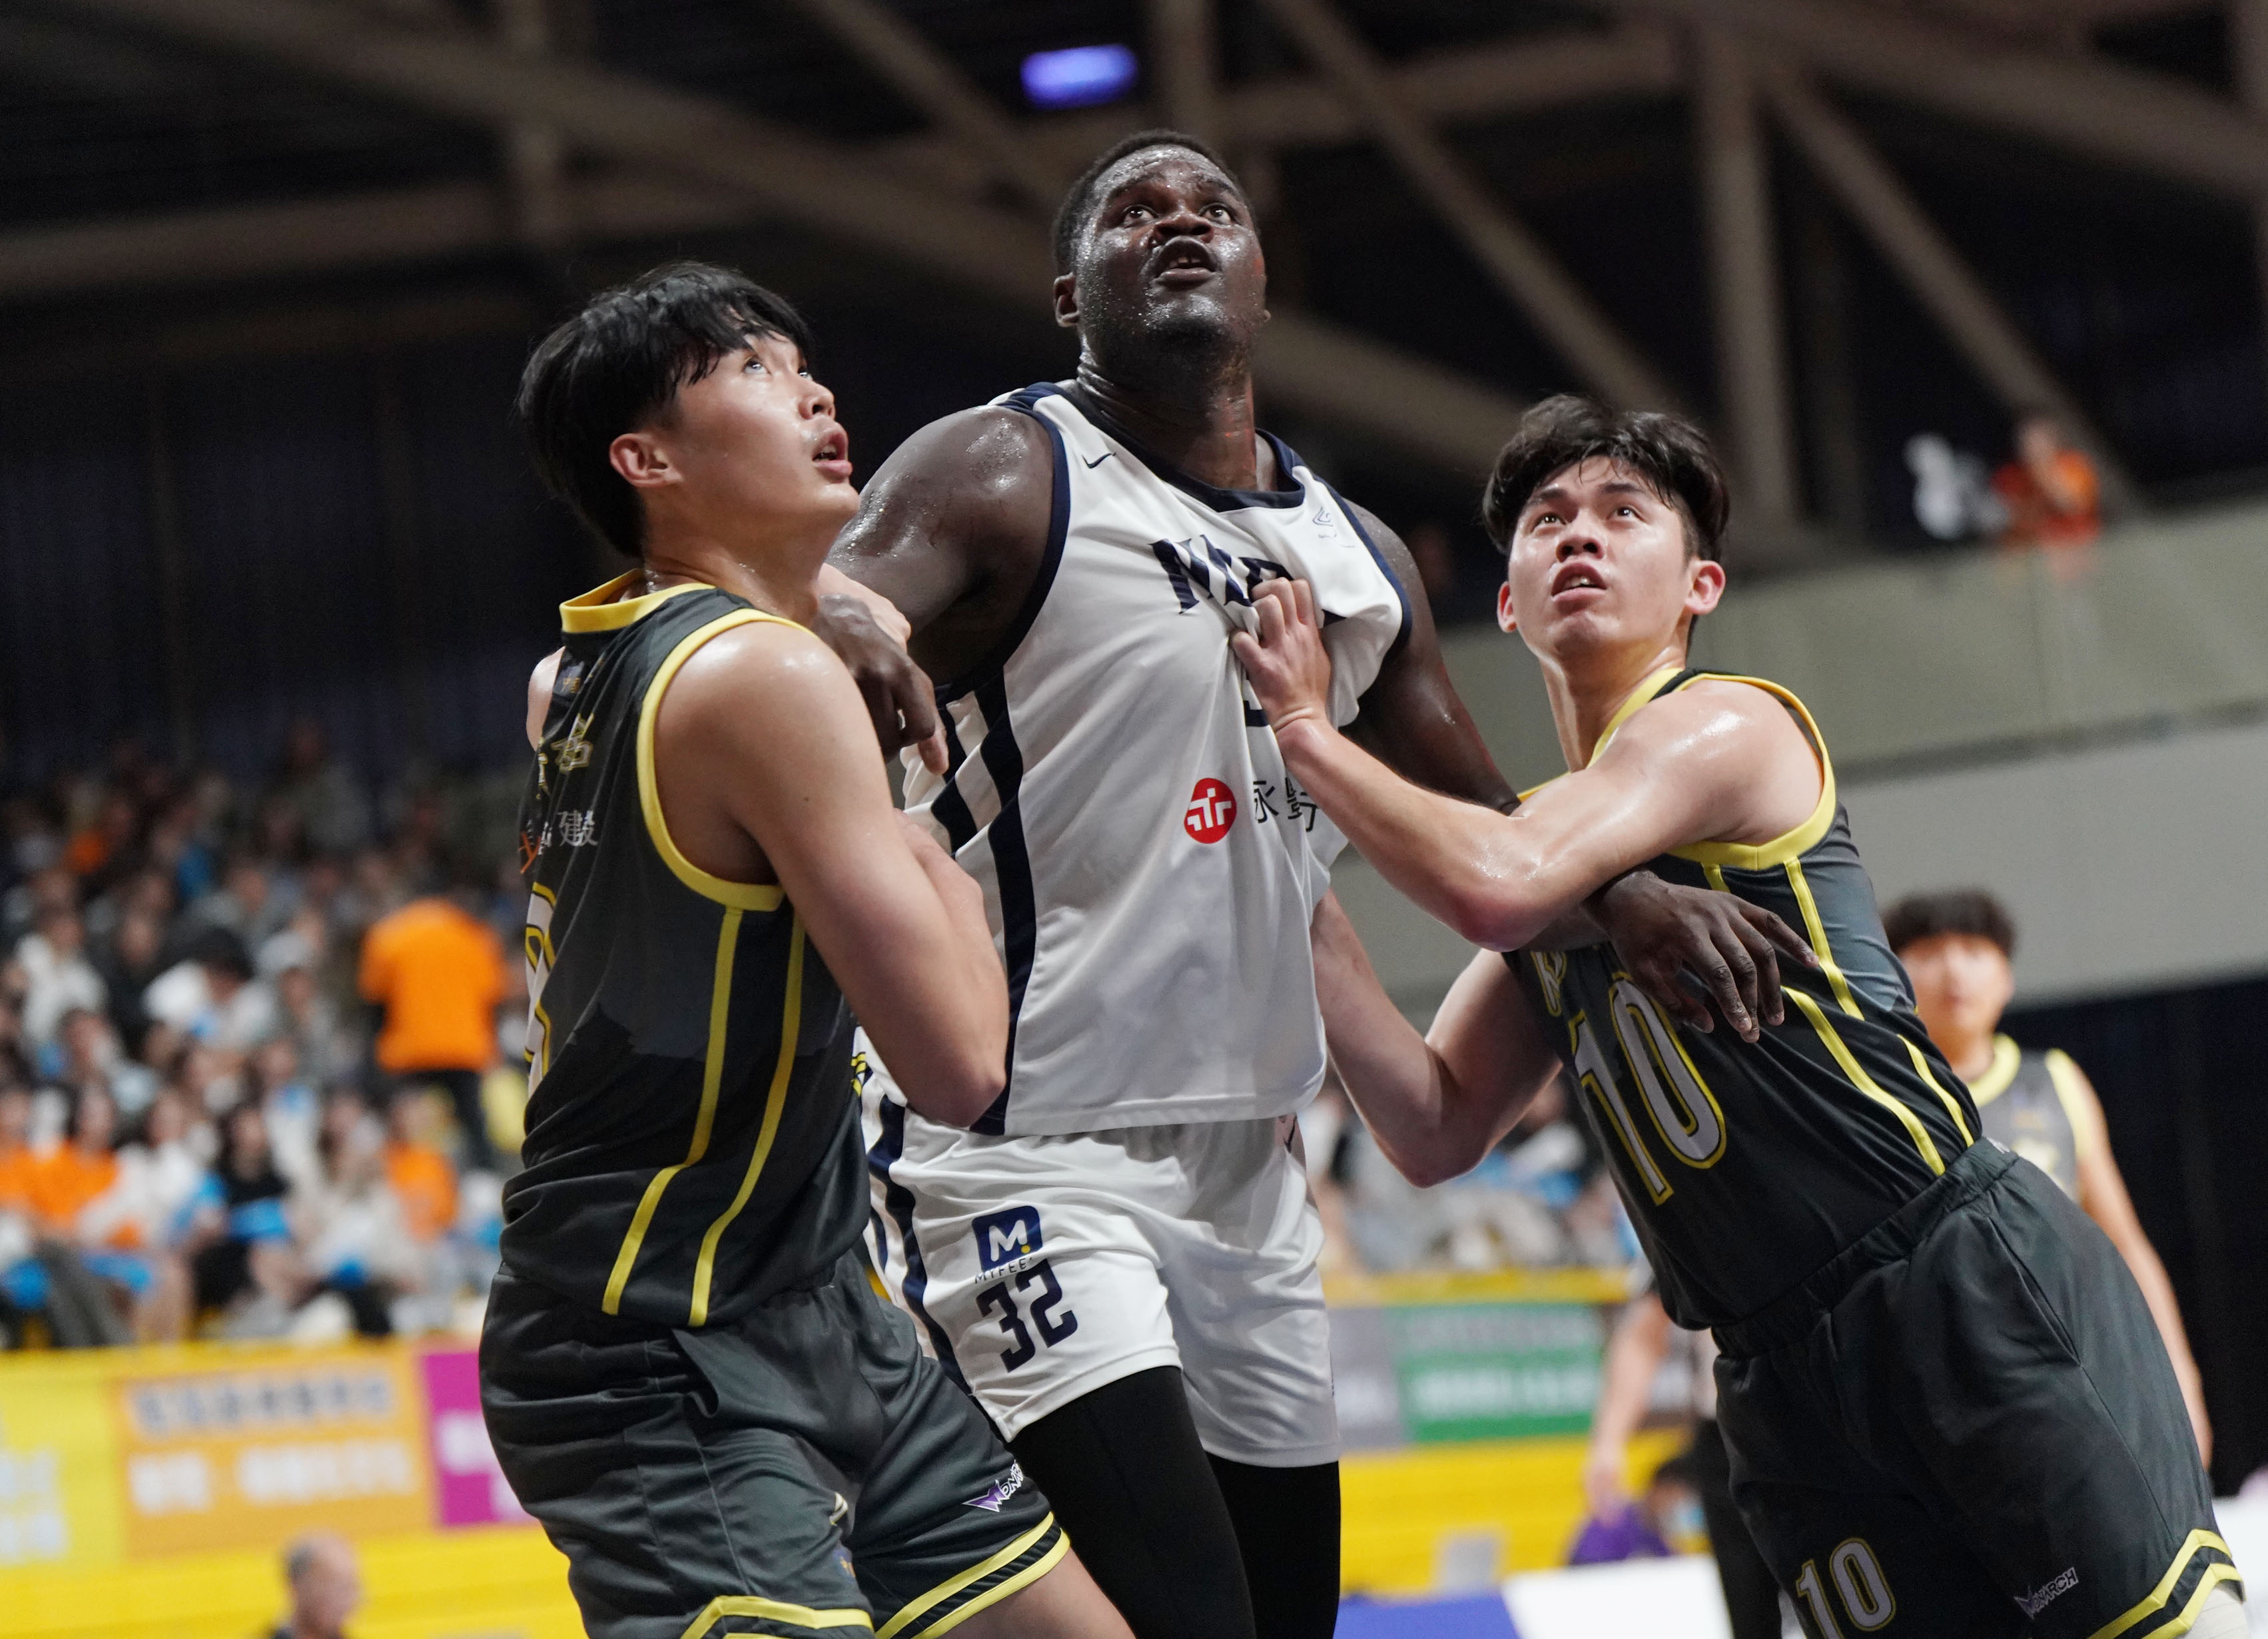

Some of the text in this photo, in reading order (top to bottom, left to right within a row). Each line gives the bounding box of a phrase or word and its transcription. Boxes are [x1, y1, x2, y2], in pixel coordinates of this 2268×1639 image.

[1567, 971, 1727, 1206] 10
[974, 1257, 1033, 1284] MYFEE
[976, 1257, 1078, 1373] 32
[1796, 1537, 1897, 1639] 10
